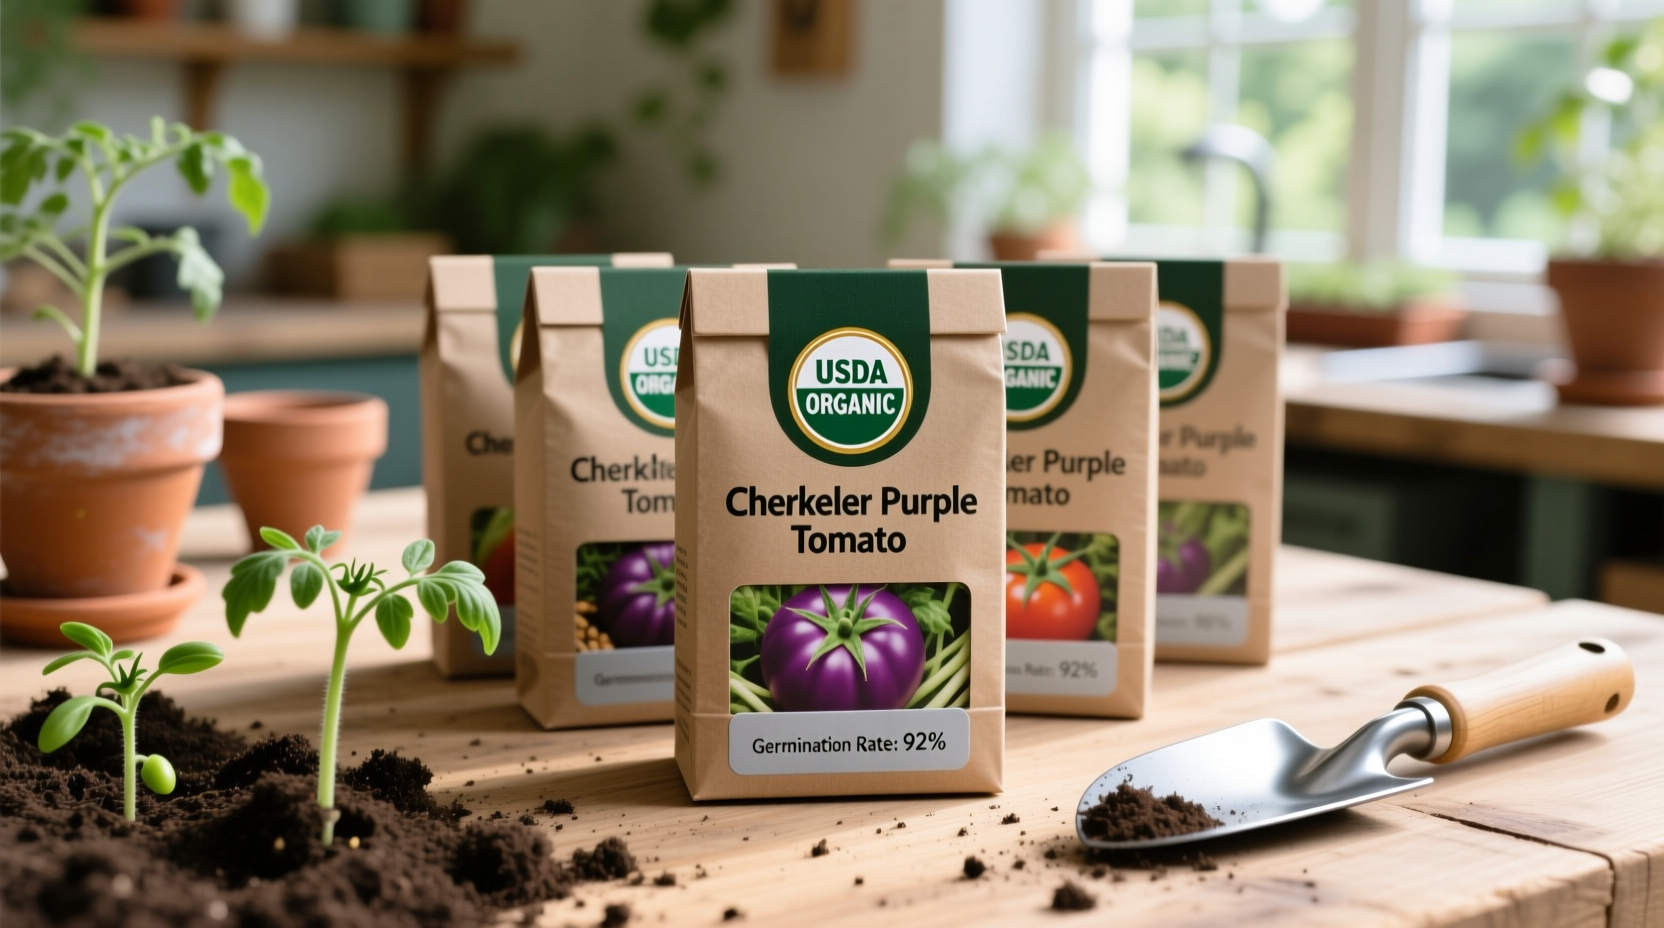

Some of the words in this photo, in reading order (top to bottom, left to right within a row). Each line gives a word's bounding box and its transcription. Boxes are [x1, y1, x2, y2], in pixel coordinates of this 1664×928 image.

[816, 359, 888, 384] USDA
[806, 393, 895, 415] ORGANIC
[1044, 449, 1126, 482] Purple
[726, 486, 872, 516] Cherkeler
[881, 485, 977, 522] Purple
[791, 525, 906, 553] Tomato
[1059, 660, 1098, 679] 92%
[752, 736, 851, 754] Germination
[857, 736, 898, 752] Rate:
[903, 732, 946, 751] 92%
